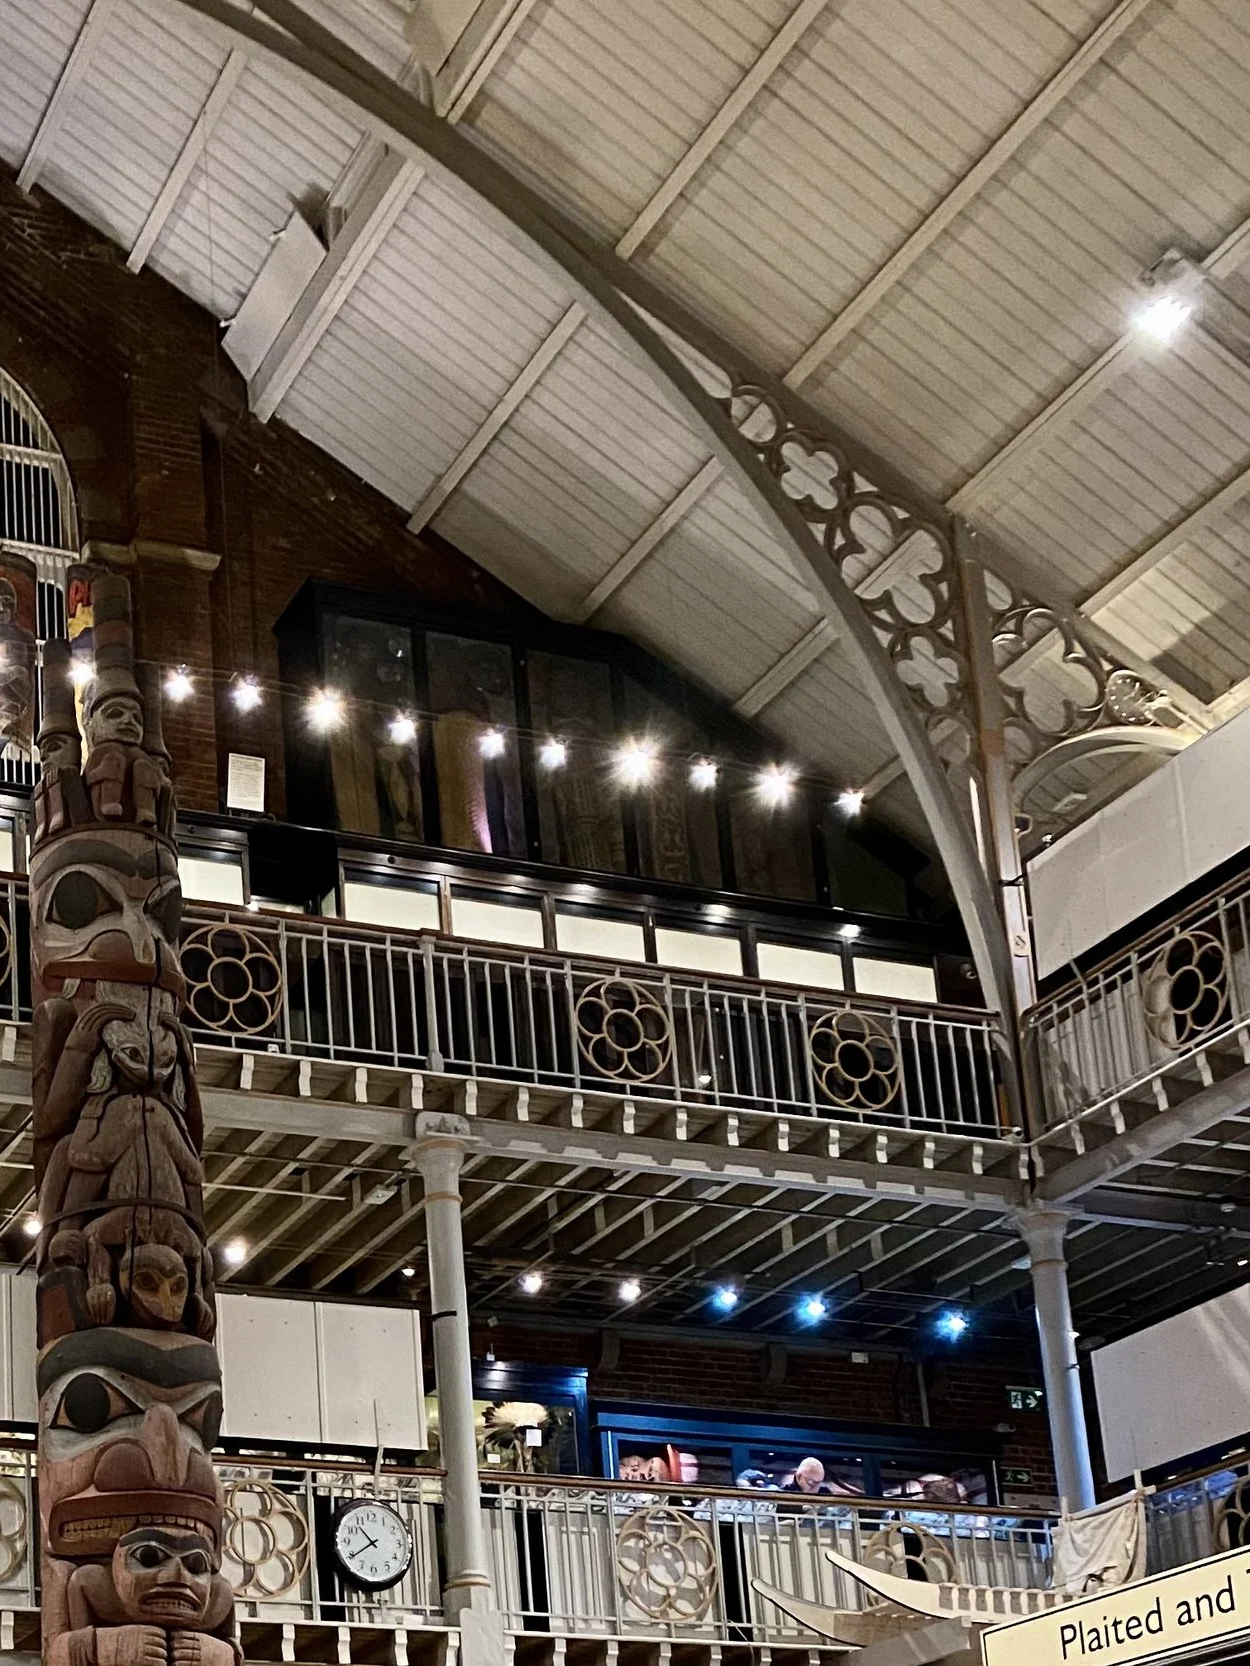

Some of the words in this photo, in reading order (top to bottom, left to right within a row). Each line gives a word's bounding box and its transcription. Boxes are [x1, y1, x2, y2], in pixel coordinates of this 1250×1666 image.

[355, 1516, 364, 1525] 11
[366, 1512, 377, 1522] 12
[382, 1516, 386, 1526] 1
[347, 1526, 358, 1535] 10
[390, 1526, 396, 1534] 2
[343, 1537, 350, 1546] 9
[396, 1540, 402, 1548] 3
[359, 1560, 365, 1570] 7
[384, 1561, 391, 1572] 5
[370, 1566, 378, 1574] 6
[1059, 1596, 1164, 1660] Plaited
[1176, 1574, 1236, 1626] and
